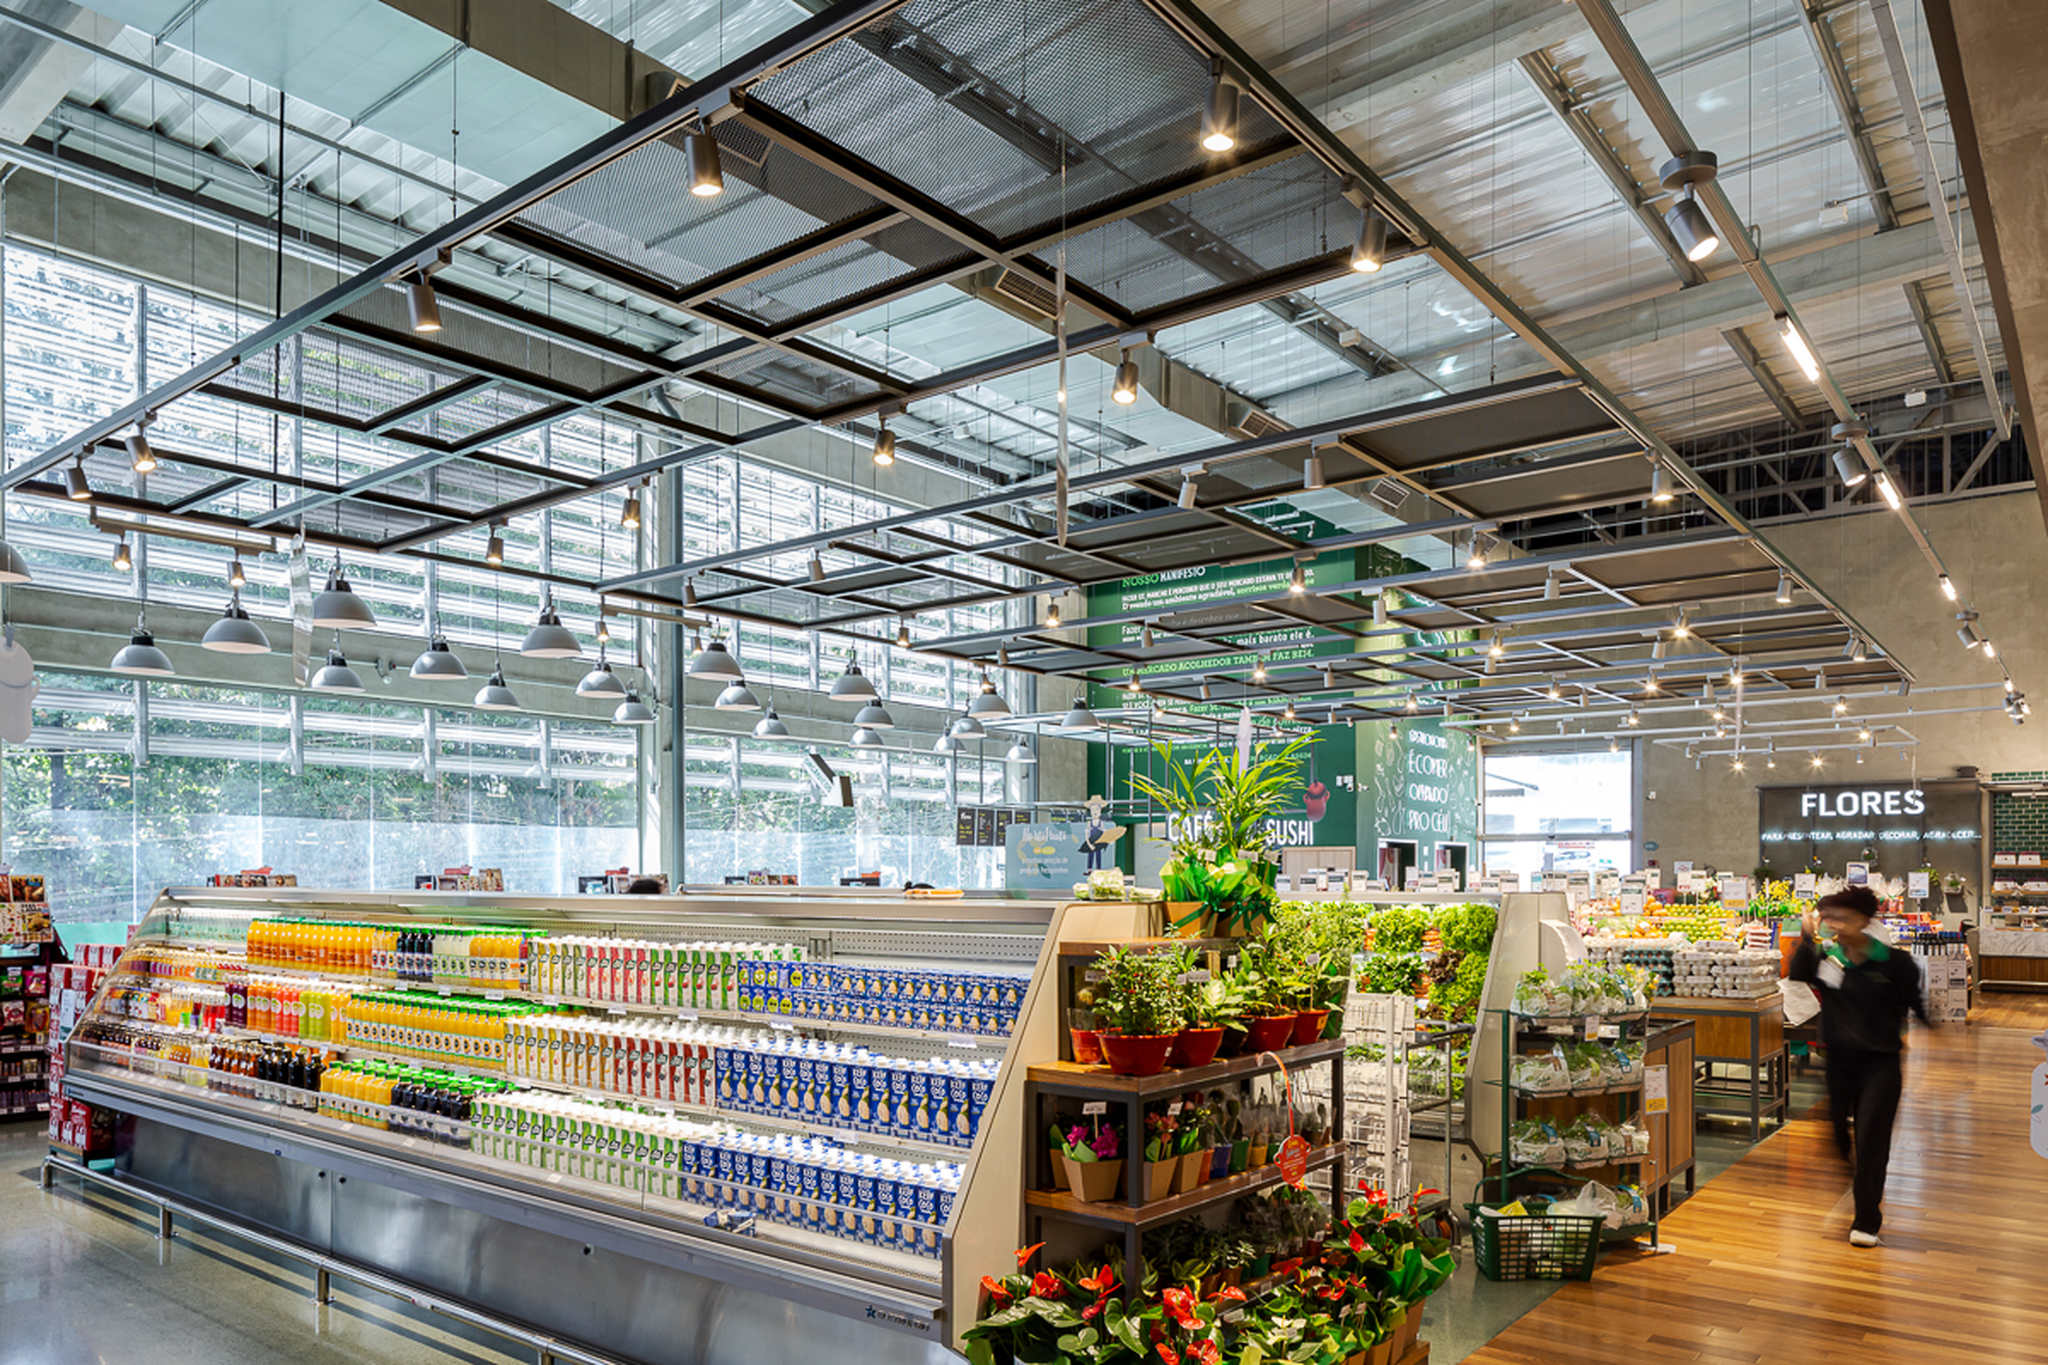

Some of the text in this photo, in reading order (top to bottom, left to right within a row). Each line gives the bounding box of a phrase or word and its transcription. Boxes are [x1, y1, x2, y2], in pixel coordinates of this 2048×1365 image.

[1122, 566, 1206, 588] NOSSO MANIFESTO
[1236, 635, 1257, 646] mais
[1258, 633, 1288, 644] barato
[1289, 630, 1302, 641] ele
[1178, 656, 1232, 671] ACOLHEDOR
[1232, 651, 1271, 665] TAMBM
[1272, 650, 1290, 661] FAZ
[1801, 790, 1925, 817] FLORES
[1168, 811, 1314, 846] CAFÉ SUSHI
